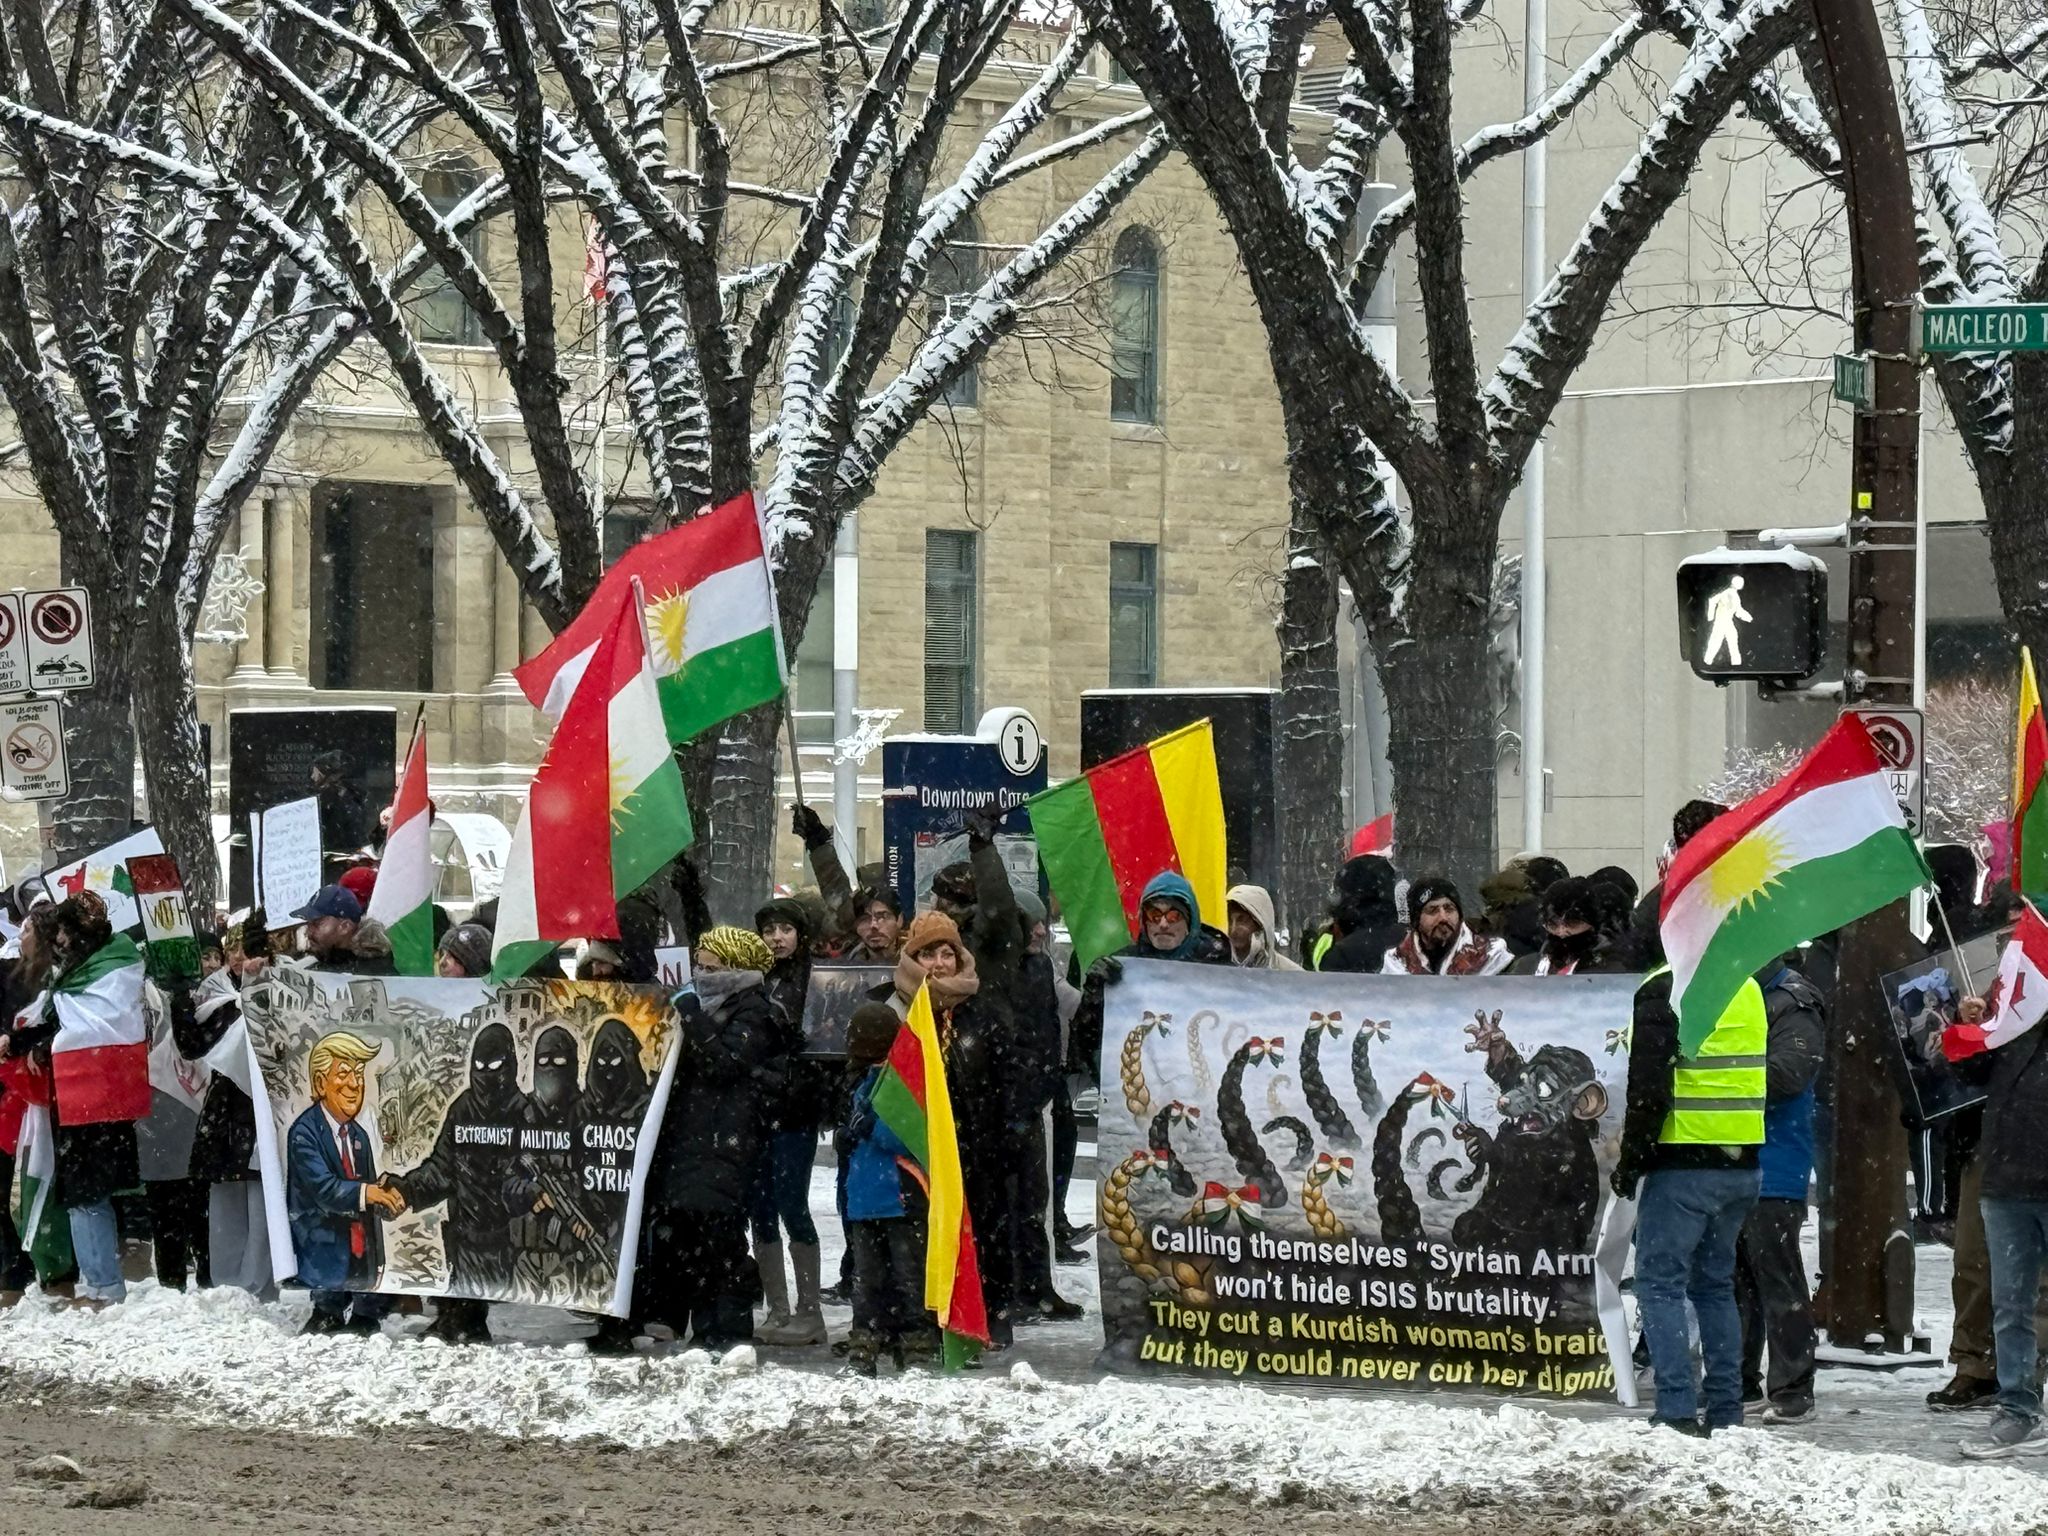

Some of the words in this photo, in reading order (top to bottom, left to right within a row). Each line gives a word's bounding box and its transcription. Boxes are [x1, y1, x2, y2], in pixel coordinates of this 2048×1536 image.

[1930, 313, 2027, 345] MACLEOD
[922, 786, 994, 808] Downtown
[455, 1125, 514, 1146] EXTREMIST
[520, 1129, 571, 1150] MILITIAS
[583, 1124, 636, 1151] CHAOS
[602, 1152, 616, 1166] IN
[583, 1166, 632, 1192] SYRIA
[1151, 1225, 1241, 1264] Calling
[1250, 1231, 1407, 1268] themselves
[1214, 1270, 1284, 1301] won't
[1291, 1273, 1350, 1305] hide
[1361, 1279, 1417, 1309] ISIS
[1426, 1282, 1557, 1324] brutality.
[1150, 1301, 1211, 1337] They
[1218, 1310, 1260, 1335] cut
[1268, 1316, 1283, 1338] a
[1291, 1312, 1398, 1344] Kurdish
[1406, 1324, 1526, 1353] woman's
[1141, 1335, 1186, 1365] but
[1193, 1341, 1249, 1376] they
[1257, 1349, 1333, 1376] could
[1341, 1356, 1421, 1381] never
[1428, 1360, 1474, 1383] cut
